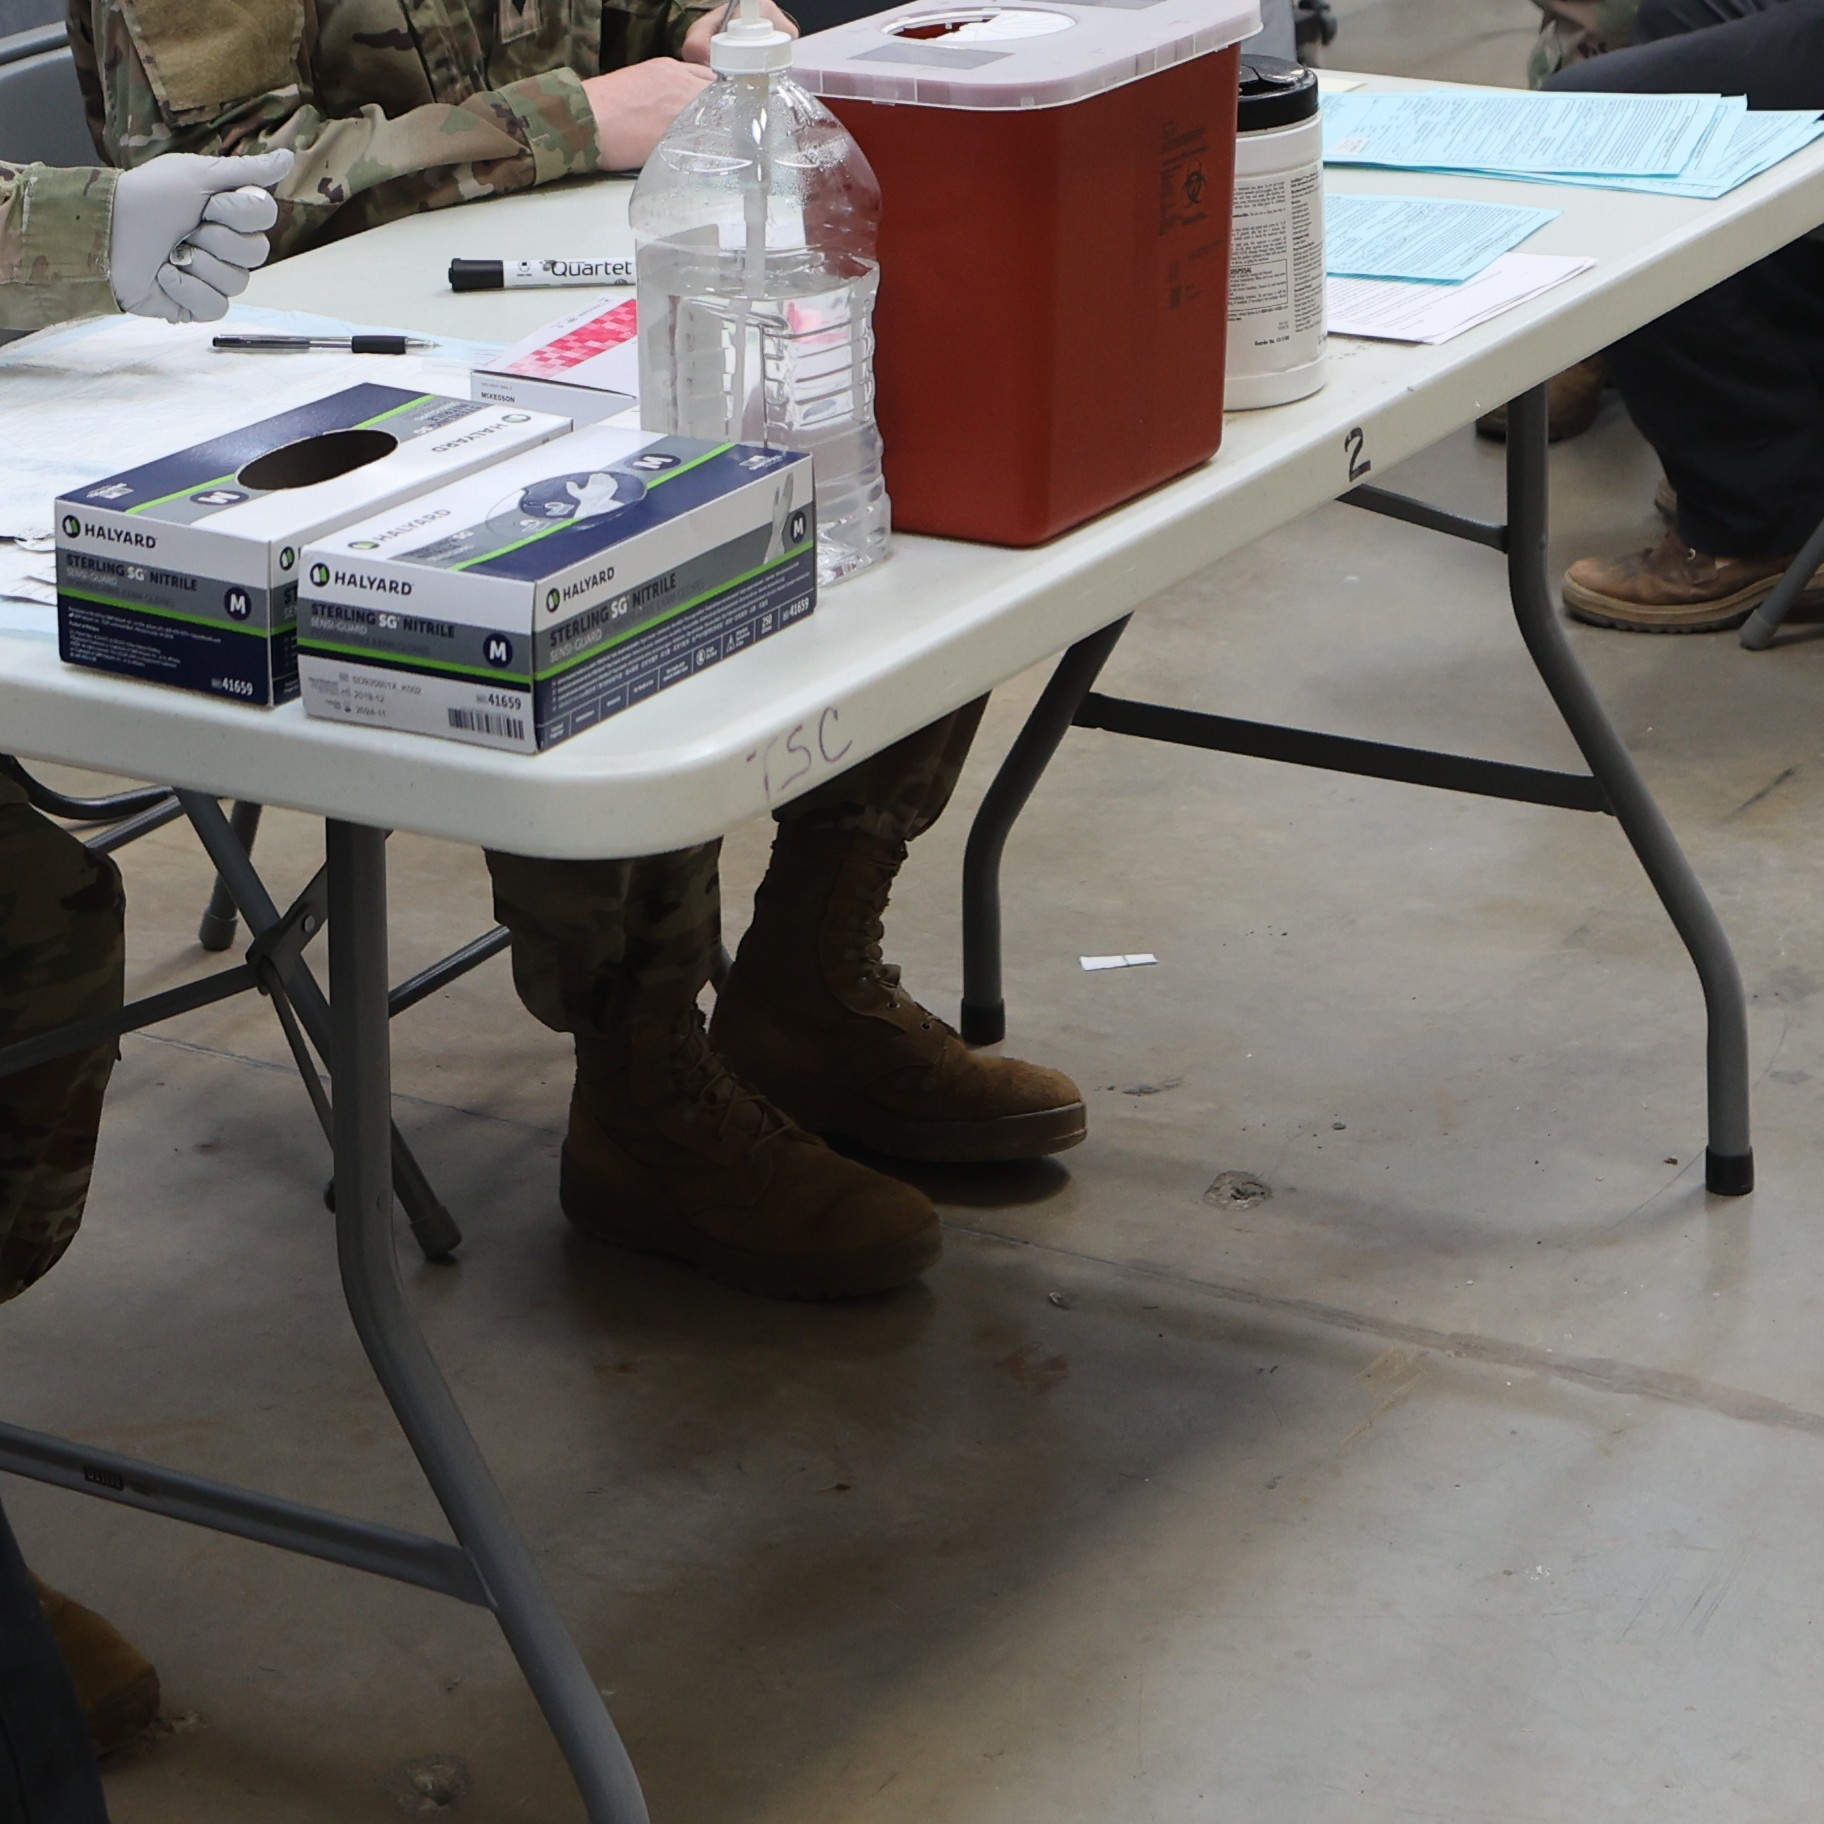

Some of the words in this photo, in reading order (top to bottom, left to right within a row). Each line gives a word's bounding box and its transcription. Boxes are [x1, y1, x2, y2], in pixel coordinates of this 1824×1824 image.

[550, 259, 633, 278] Quartet
[1344, 426, 1372, 483] 2
[84, 522, 157, 549] HALYARD
[372, 509, 451, 542] HALYARD
[65, 553, 126, 577] STERLING
[149, 570, 198, 592] NITRILE
[334, 570, 413, 596] HALYARD
[563, 567, 616, 602] HALYARD
[229, 595, 246, 615] M
[550, 603, 609, 646] STERLING
[632, 573, 676, 606] NITRILE
[311, 602, 376, 625] STERLING
[403, 617, 455, 639] NITRILE
[489, 640, 507, 662] M
[221, 677, 254, 696] 41659
[488, 692, 522, 710] 41659
